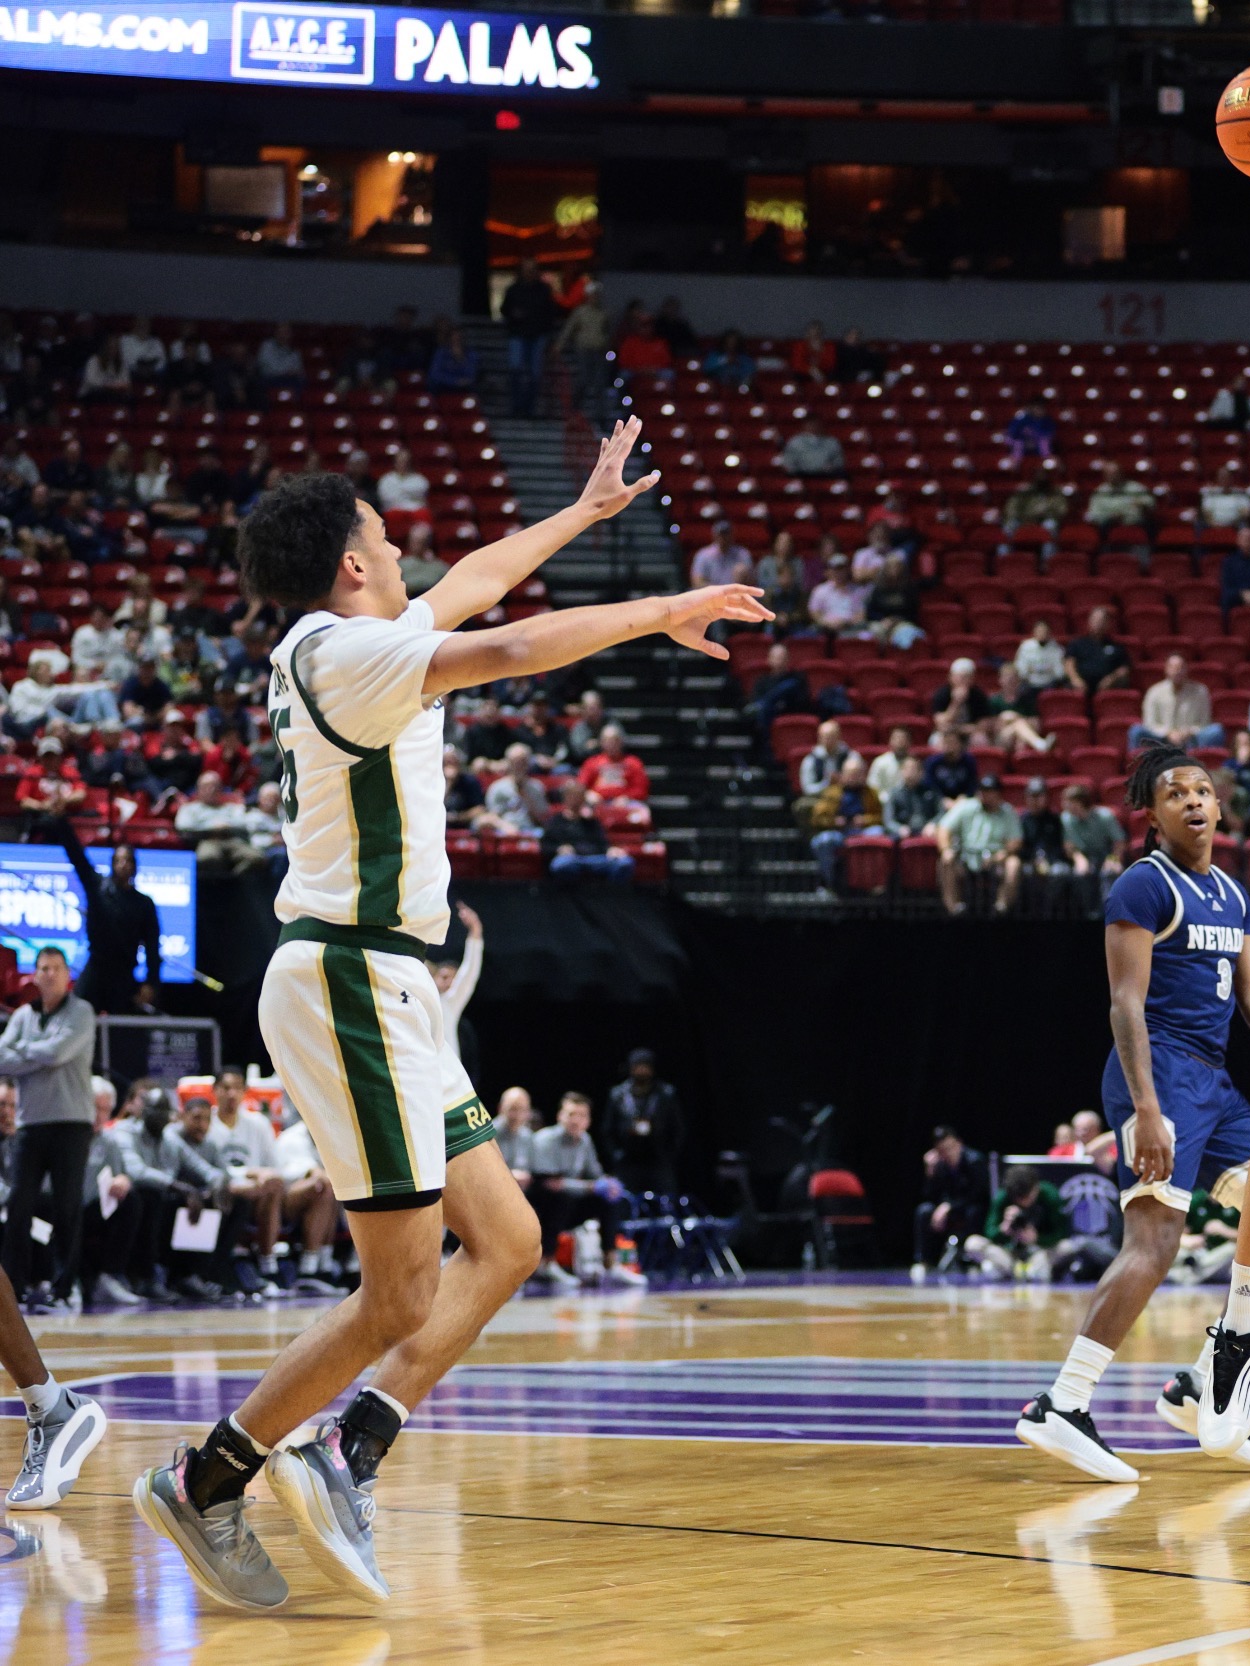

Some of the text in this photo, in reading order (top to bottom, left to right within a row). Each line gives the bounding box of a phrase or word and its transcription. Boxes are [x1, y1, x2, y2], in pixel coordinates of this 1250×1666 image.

[1100, 292, 1166, 336] 121
[1187, 923, 1245, 954] NEVAD
[1216, 957, 1233, 1001] 3
